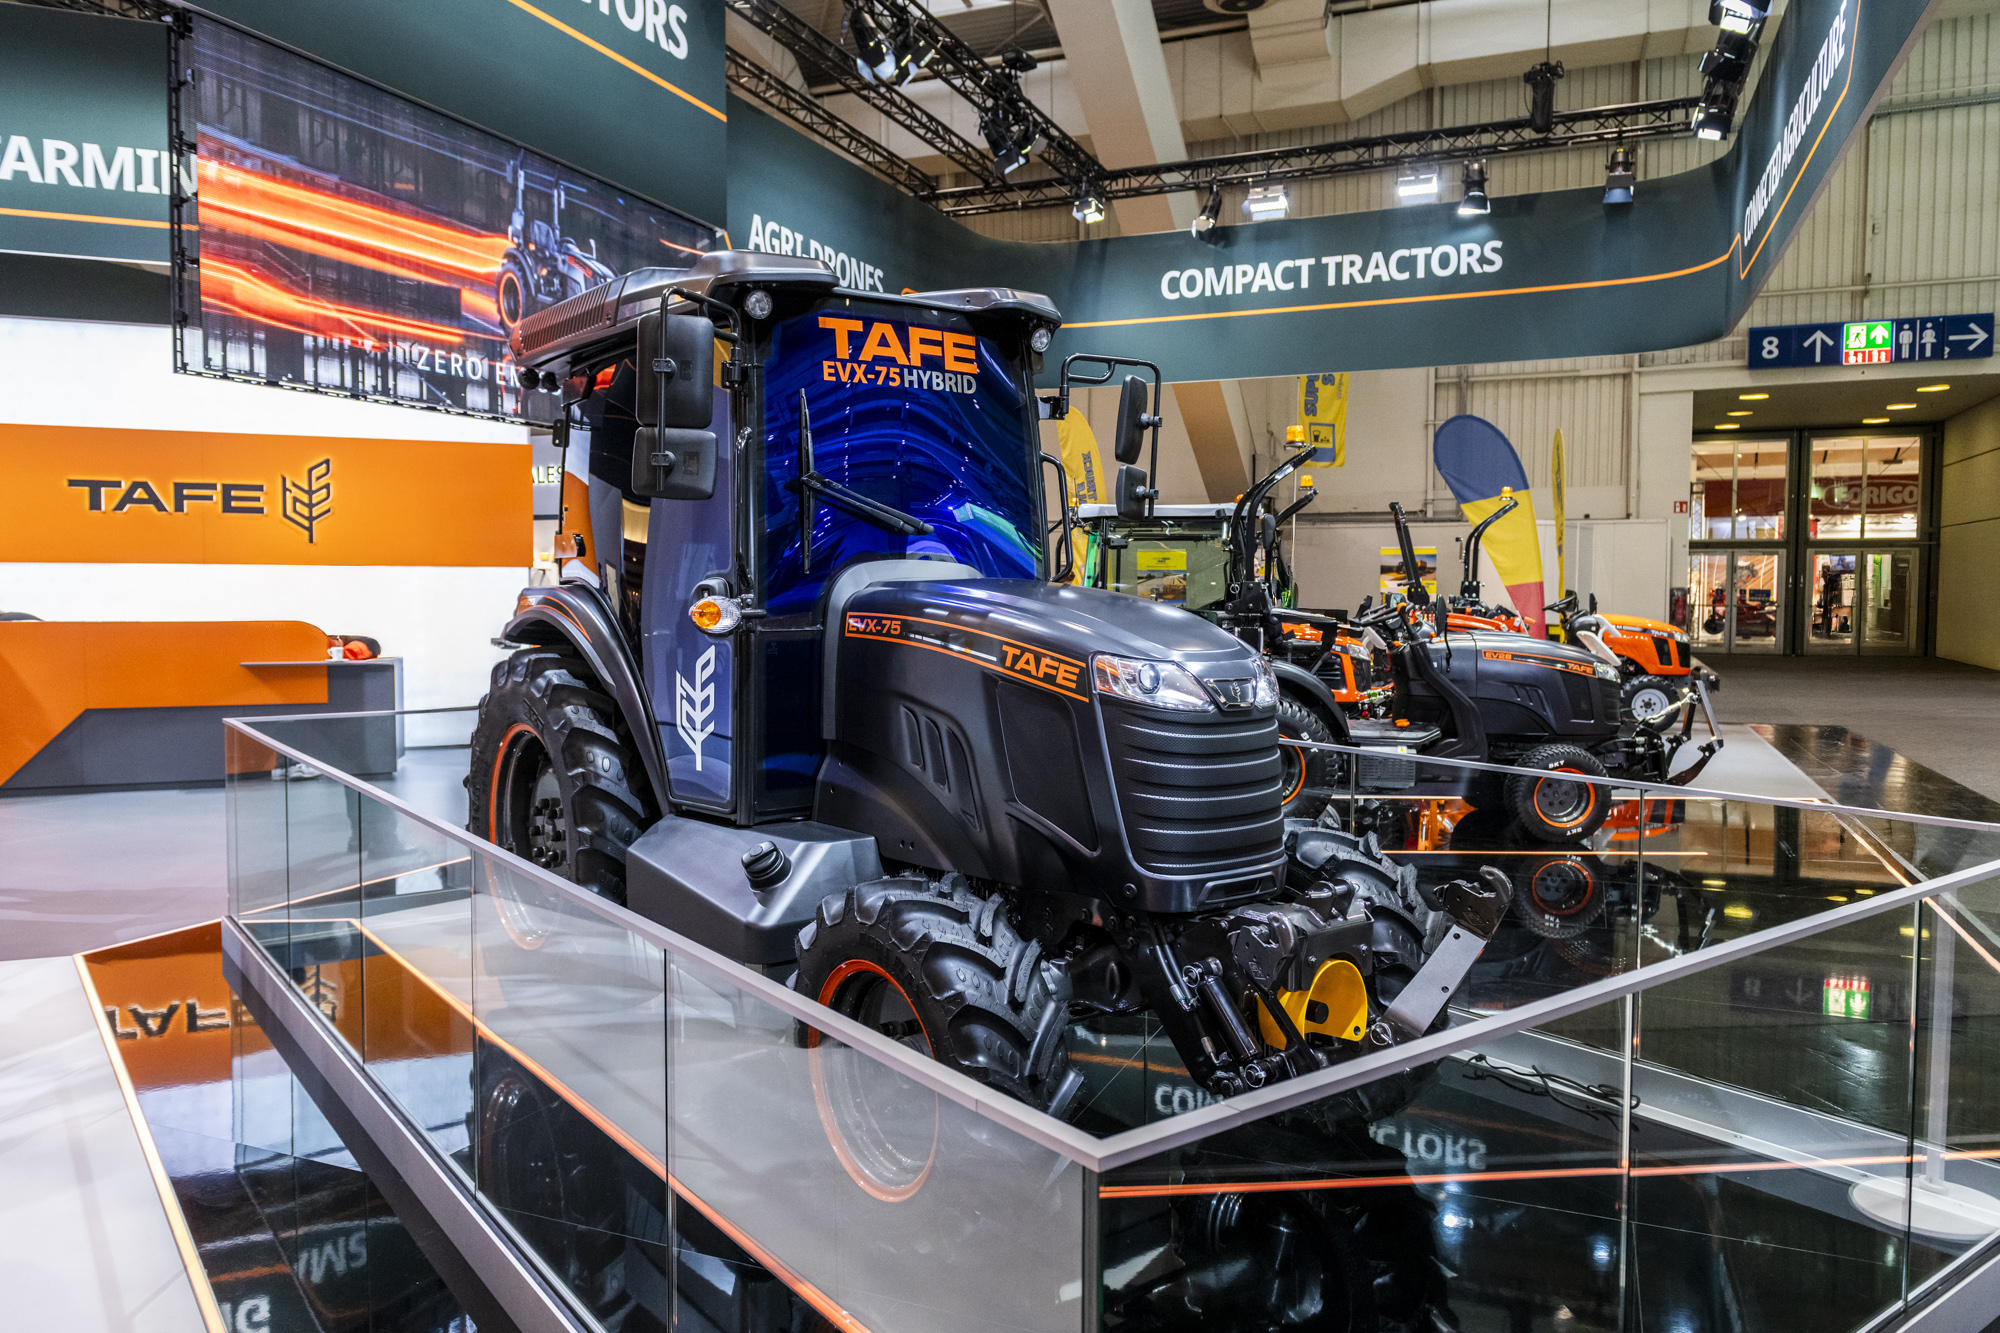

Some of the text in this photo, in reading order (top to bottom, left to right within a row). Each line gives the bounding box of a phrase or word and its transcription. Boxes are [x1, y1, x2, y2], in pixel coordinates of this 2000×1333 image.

[1743, 0, 1848, 247] CONNECTED AGRICULTURE
[1160, 240, 1503, 300] COMPACT TRACTORS
[818, 316, 978, 375] TAFE
[1761, 336, 1779, 360] 8
[417, 346, 482, 381] ZERO
[822, 360, 977, 395] EVX-75 HYBRID
[67, 479, 268, 515] TAFE
[848, 618, 902, 636] EVX-75
[1001, 644, 1080, 690] TAFE
[1566, 662, 1594, 675] TAFE
[1548, 759, 1565, 769] BKT
